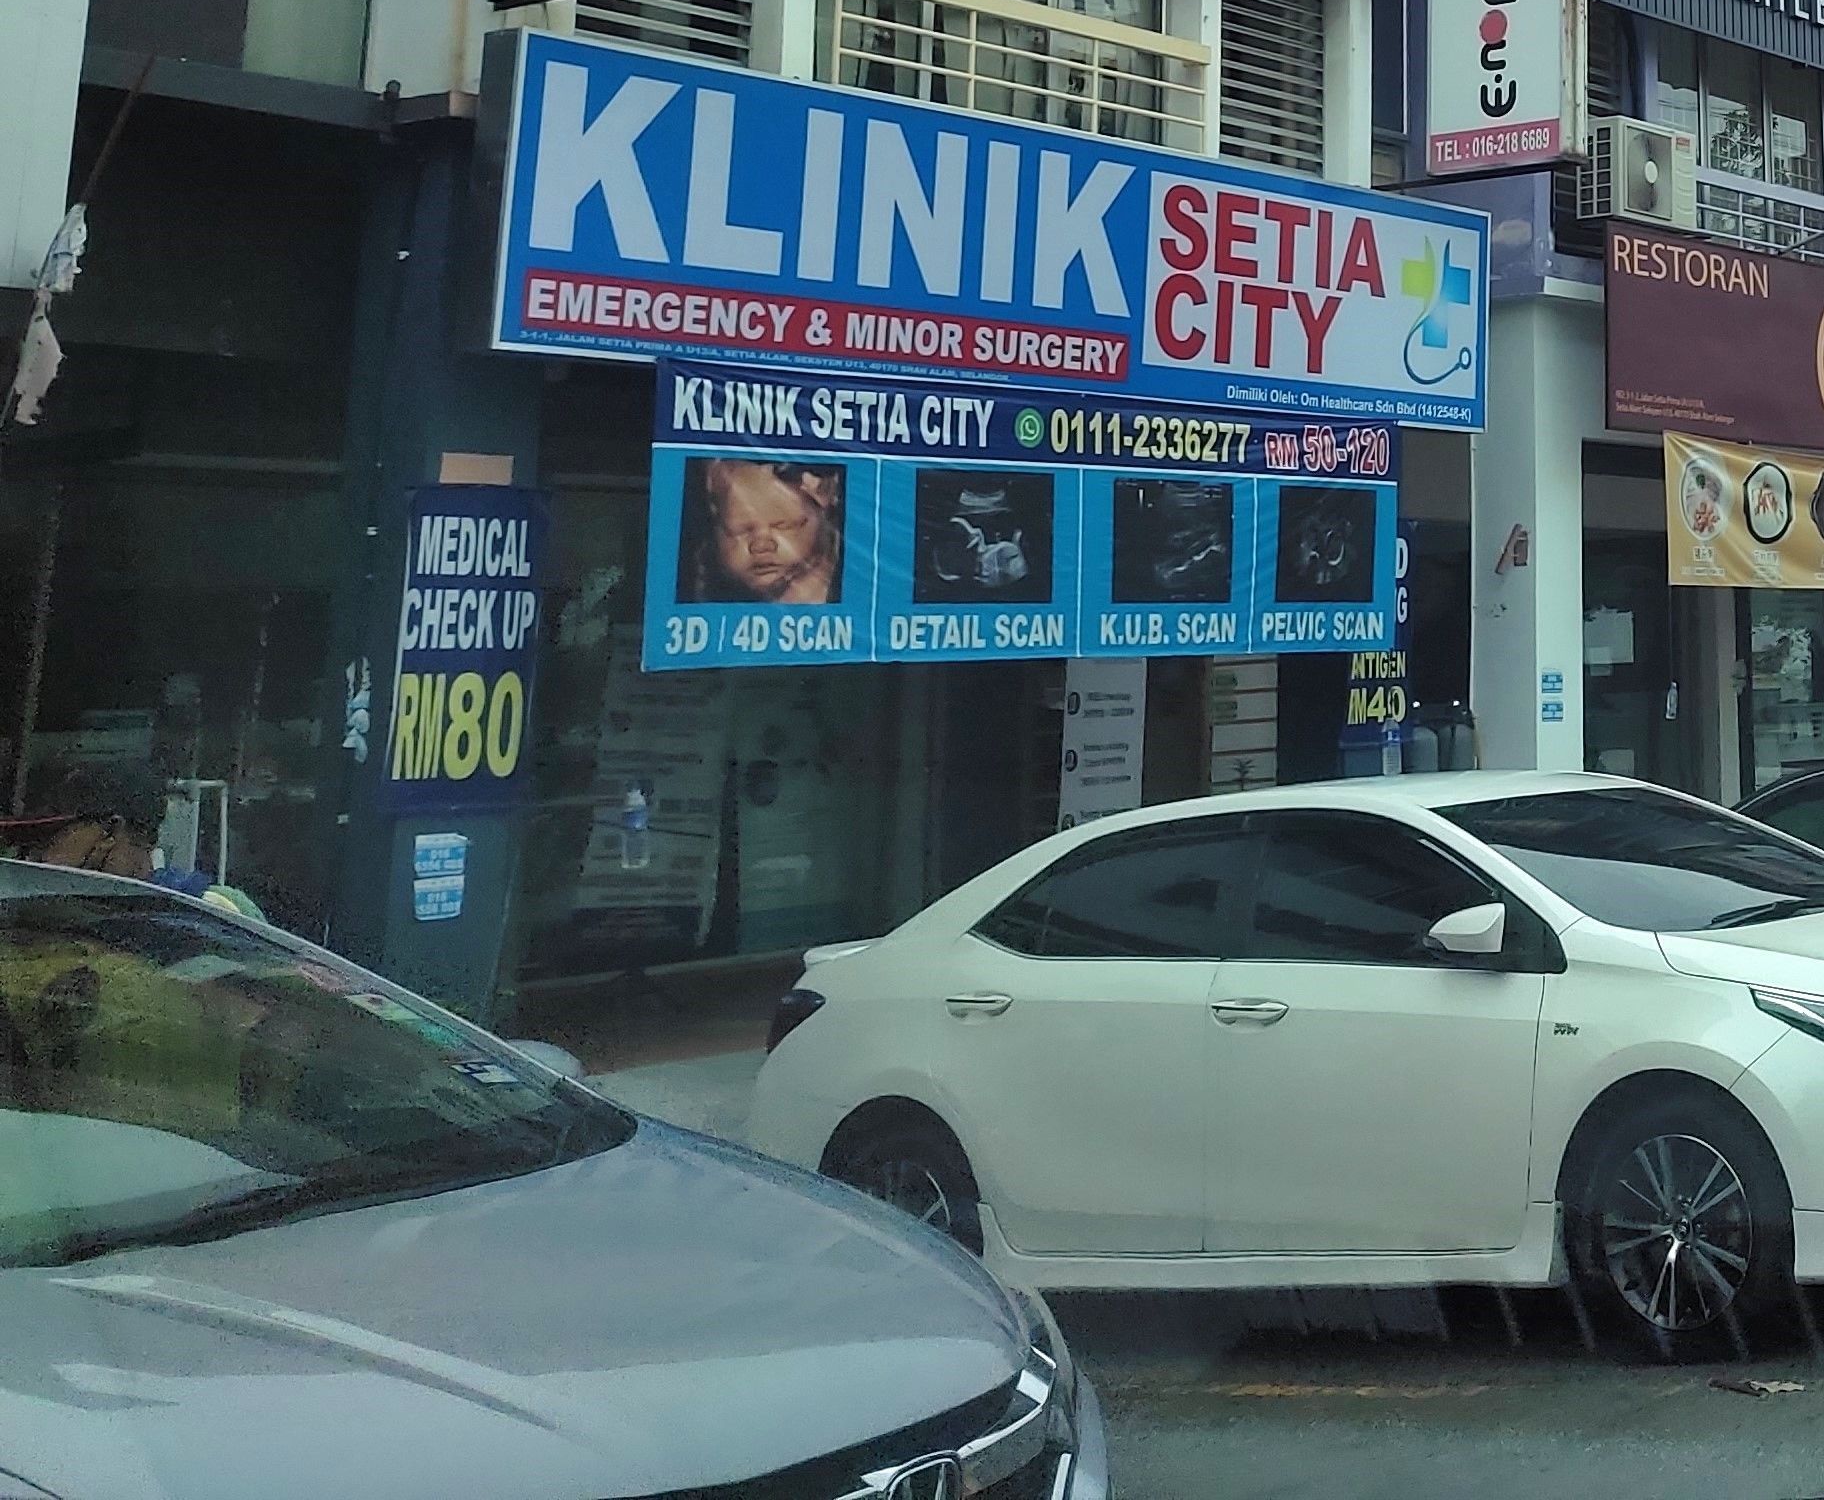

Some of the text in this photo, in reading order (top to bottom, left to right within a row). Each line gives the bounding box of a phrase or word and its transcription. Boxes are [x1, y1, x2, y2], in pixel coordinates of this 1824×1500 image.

[1472, 131, 1519, 158] 016-218
[1521, 127, 1551, 152] 6689
[528, 59, 1137, 319] KLINIK
[1159, 184, 1386, 298] SETIA
[1613, 234, 1769, 298] RESTORAN
[527, 277, 1126, 376] EMERGENCY & MINOR SURGERY
[555, 332, 595, 346] JALAN
[599, 337, 633, 349] SETIA
[723, 347, 757, 360] SETIA
[1154, 272, 1343, 375] CITY
[673, 376, 1391, 477] KLINIK SETIA CITY 0111-2336277 RM 50-120
[1227, 385, 1268, 402] Dimiliki
[1301, 392, 1319, 408] Om
[1321, 394, 1374, 413] Healthcare
[1375, 399, 1395, 415] Sdn
[1396, 401, 1416, 417] Bhd
[416, 515, 531, 578] MEDICAL
[404, 588, 536, 652] CHECK UP
[665, 616, 709, 656] 3D
[732, 615, 770, 652] 4D
[778, 614, 852, 651] SCAN
[889, 612, 1063, 651] DETAIL SCAN
[1100, 612, 1237, 647] K.U.B. SCAN
[1261, 611, 1385, 643] PELVIC SCAN
[391, 671, 524, 782] RM80
